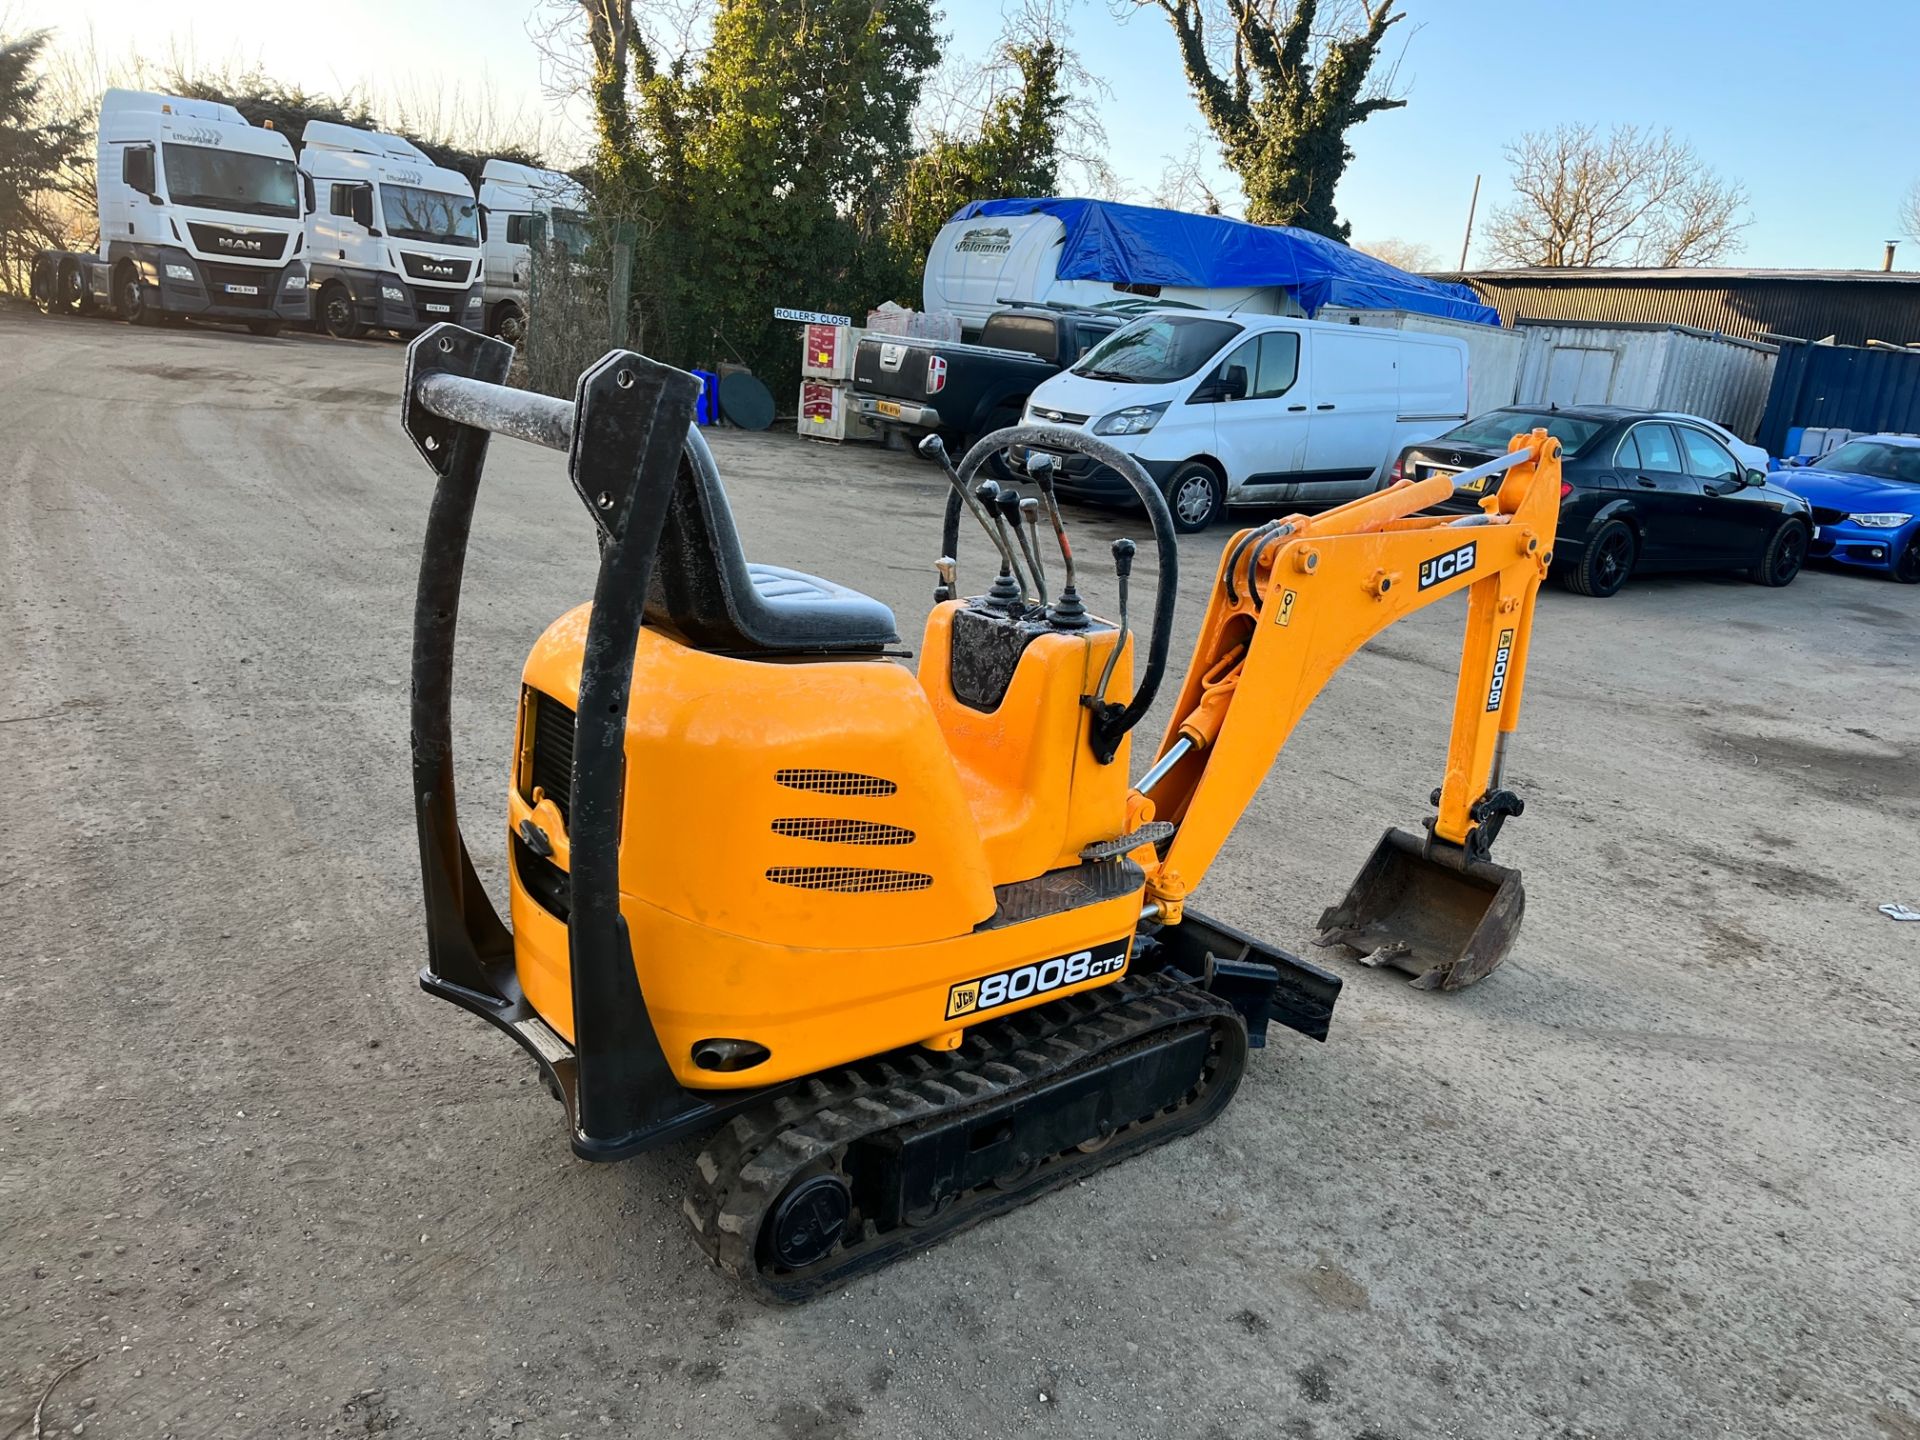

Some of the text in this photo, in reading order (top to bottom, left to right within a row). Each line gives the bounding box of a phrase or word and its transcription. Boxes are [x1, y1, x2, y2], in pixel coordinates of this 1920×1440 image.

[218, 237, 261, 251] MAN
[955, 240, 1011, 254] Palomino
[422, 264, 453, 275] MAN
[776, 309, 850, 326] ROLLERS CLOSE
[1421, 546, 1474, 587] JCB
[1488, 648, 1509, 704] 8008
[955, 990, 975, 1010] JCB
